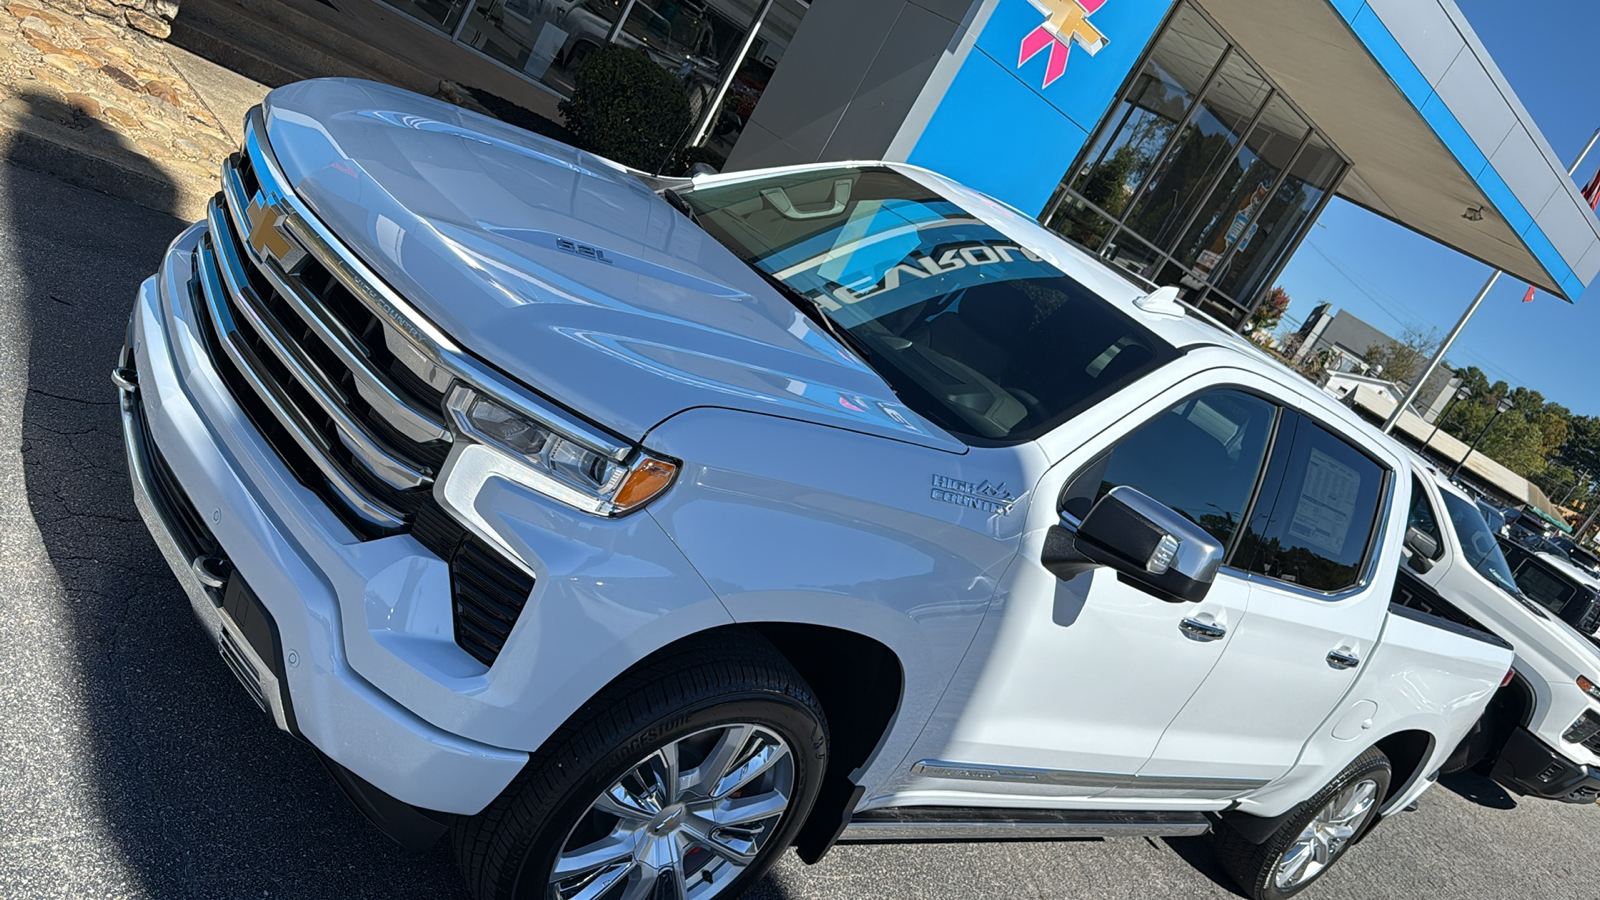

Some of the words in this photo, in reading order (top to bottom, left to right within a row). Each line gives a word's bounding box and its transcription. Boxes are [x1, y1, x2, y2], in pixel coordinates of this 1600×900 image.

[376, 298, 427, 342] COUNTRY
[931, 473, 978, 495] HIGH
[931, 487, 1013, 517] COUNTRY
